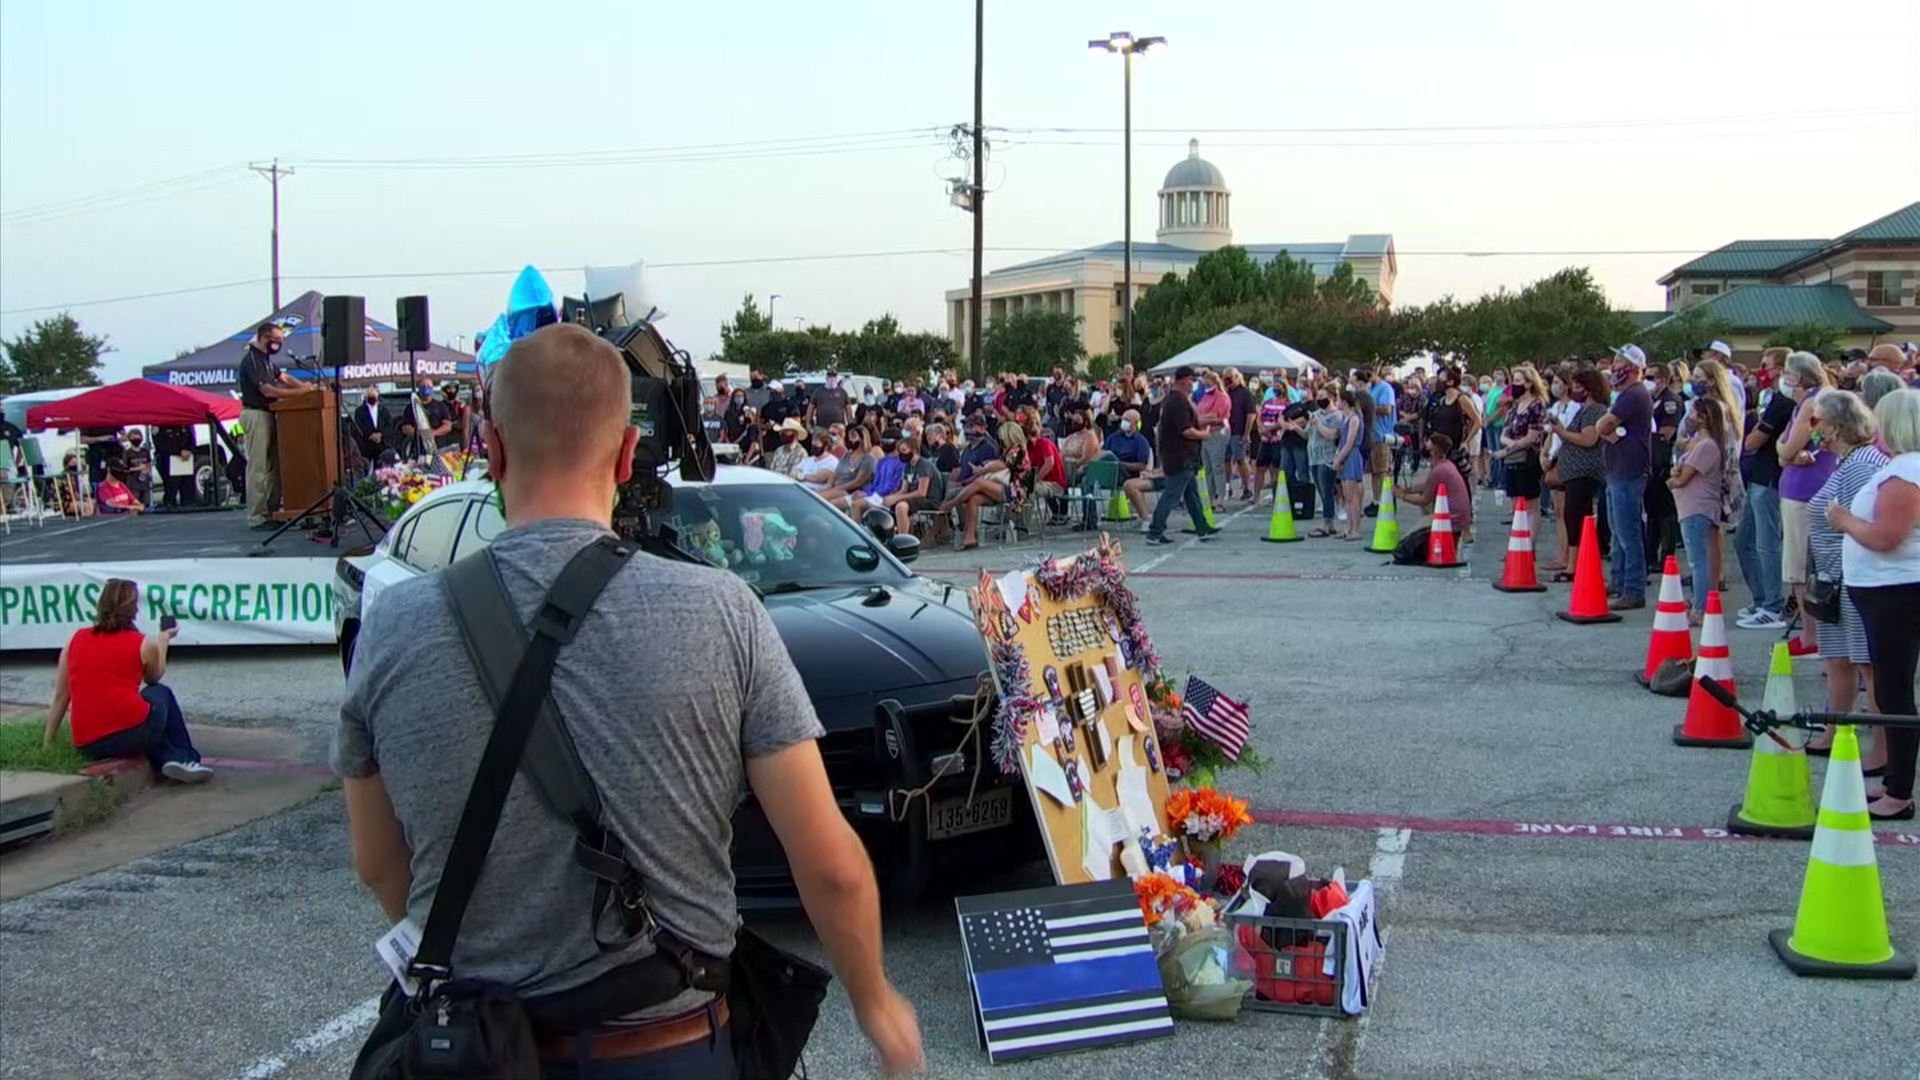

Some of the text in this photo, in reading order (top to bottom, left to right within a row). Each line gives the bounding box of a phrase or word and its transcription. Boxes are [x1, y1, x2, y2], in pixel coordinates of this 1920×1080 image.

[169, 369, 236, 385] ROCKWALL
[343, 359, 457, 378] ROCKWALL POLICE
[0, 583, 100, 625] PARKS
[1514, 823, 1684, 837] FIRE LANE
